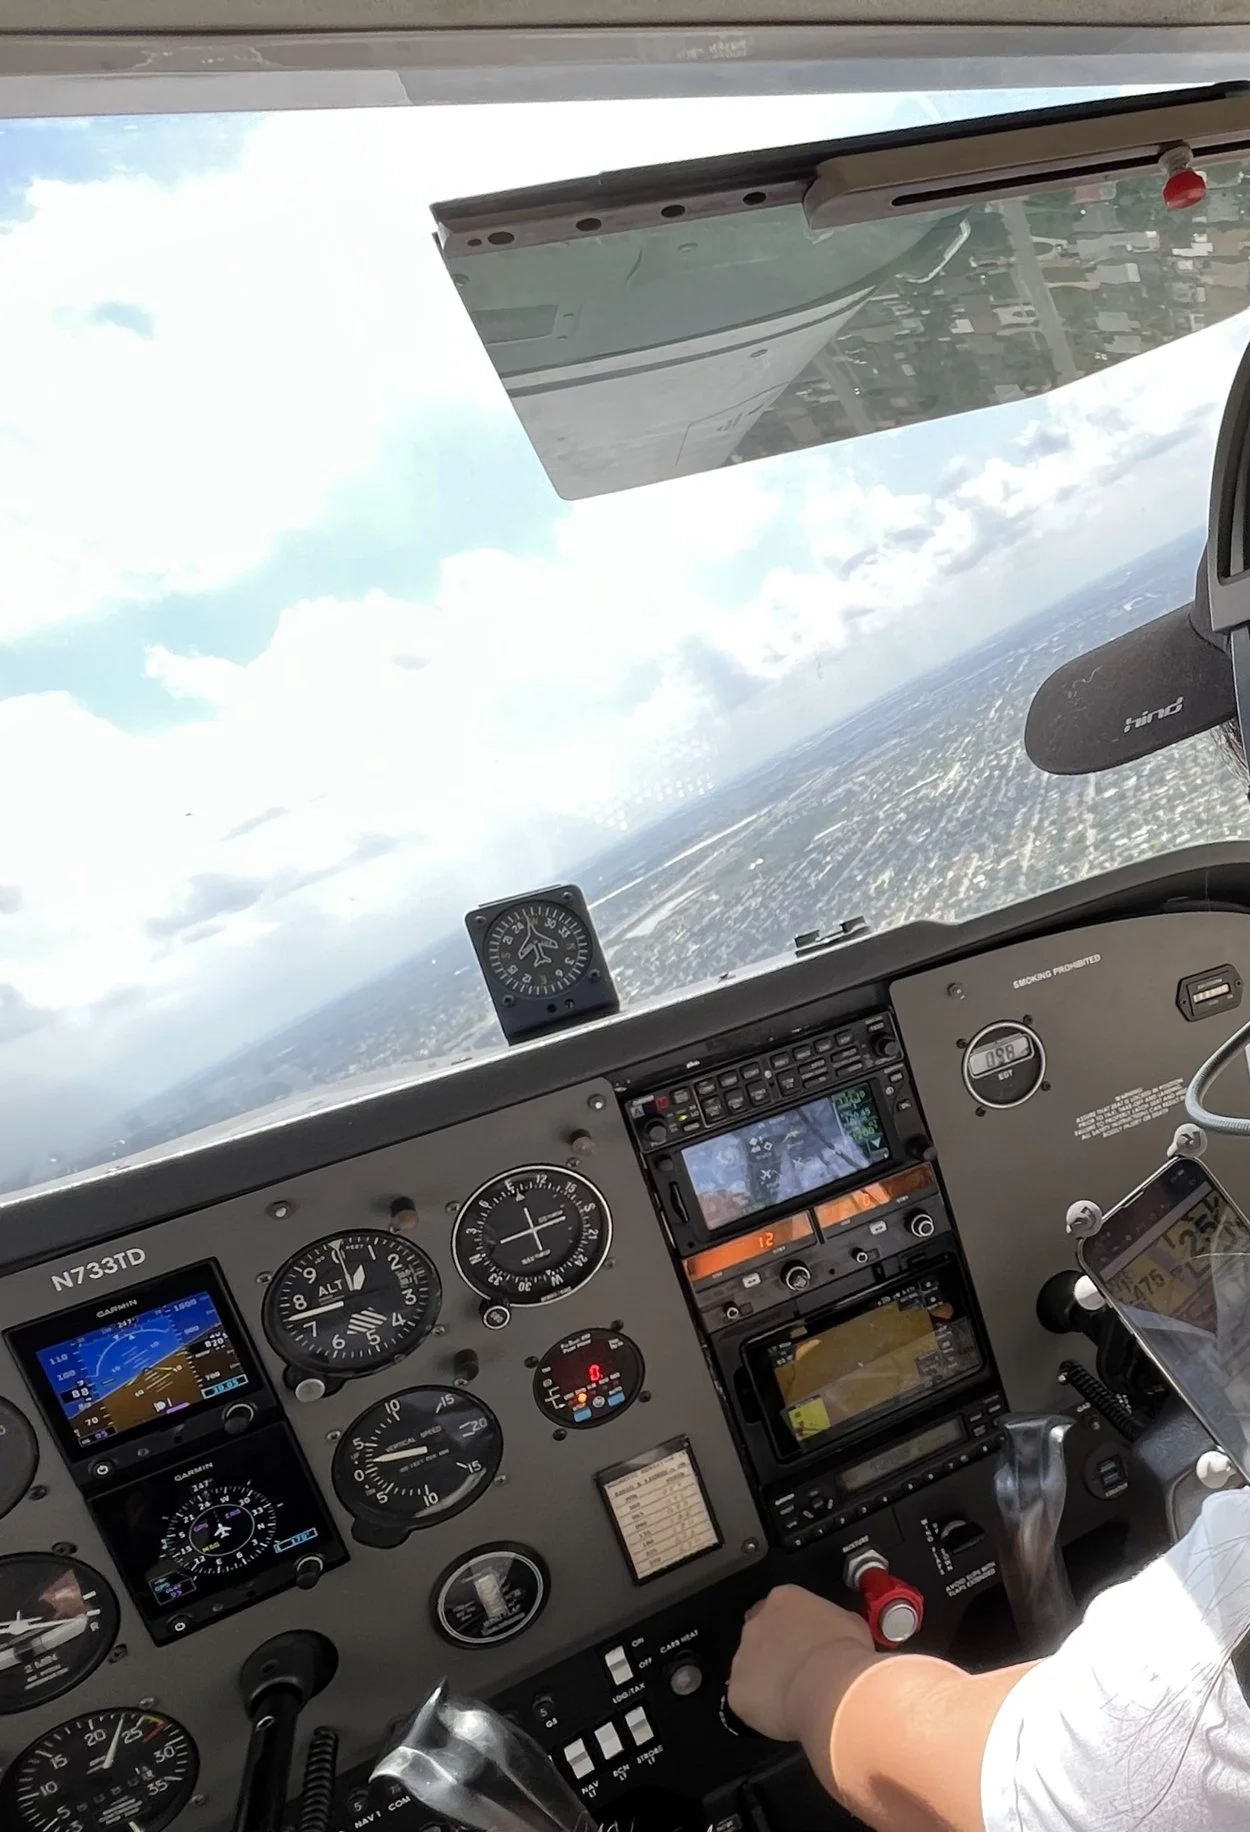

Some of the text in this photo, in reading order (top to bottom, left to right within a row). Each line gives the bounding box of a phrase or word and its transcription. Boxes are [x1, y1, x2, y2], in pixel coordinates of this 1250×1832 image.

[511, 922, 525, 934] 24
[544, 918, 557, 929] 30
[558, 927, 570, 939] 33
[1013, 953, 1101, 989] SMOKING PROHIBITED
[505, 1179, 515, 1191] E
[536, 1174, 548, 1184] 12
[565, 1181, 577, 1193] 15
[584, 1203, 596, 1212] S
[588, 1228, 599, 1240] 21
[758, 1232, 774, 1248] 12
[388, 1254, 401, 1270] 2
[469, 1254, 482, 1265] N
[574, 1254, 588, 1268] 24
[51, 1248, 146, 1292] N733TD
[303, 1266, 317, 1284] 9
[488, 1273, 502, 1286] 33
[552, 1274, 564, 1286] W
[318, 1279, 342, 1296] ALT
[518, 1281, 532, 1292] 30
[292, 1294, 308, 1310] 8
[402, 1288, 417, 1305] 3
[96, 1300, 138, 1318] GARMIN
[392, 1312, 406, 1328] 4
[303, 1320, 317, 1338] 7
[332, 1334, 346, 1350] 6
[366, 1329, 380, 1346] 5
[50, 1354, 68, 1366] 110
[57, 1370, 76, 1381] 100
[440, 1393, 455, 1406] 15
[384, 1400, 400, 1414] 10
[85, 1416, 99, 1427] 70
[471, 1418, 488, 1432] 20
[420, 1425, 442, 1438] SPEED
[352, 1438, 364, 1450] 5
[174, 1462, 214, 1482] GARMIN
[468, 1460, 482, 1473] 15
[354, 1470, 364, 1482] 0
[220, 1495, 230, 1504] W
[238, 1496, 251, 1506] 30
[376, 1491, 388, 1504] 5
[424, 1492, 438, 1506] 10
[198, 1501, 212, 1511] 24
[252, 1507, 264, 1516] 33
[183, 1514, 194, 1524] 21
[257, 1522, 266, 1530] N
[178, 1531, 186, 1539] S
[202, 1542, 220, 1552] MSG
[252, 1538, 258, 1546] 3
[90, 1621, 100, 1632] R
[631, 1637, 644, 1648] ON
[660, 1630, 699, 1654] CARB HEAT
[638, 1657, 652, 1669] OFF
[540, 1708, 548, 1717] 5
[84, 1729, 106, 1746] 20
[122, 1727, 143, 1744] 25
[153, 1746, 175, 1764] 30
[636, 1744, 664, 1764] STROBE
[648, 1756, 656, 1765] LT
[51, 1754, 68, 1770] 15
[612, 1764, 630, 1778] BCN
[620, 1772, 628, 1782] LT
[40, 1781, 58, 1796] 10
[147, 1780, 168, 1796] 35
[582, 1780, 600, 1794] NAV
[589, 1790, 597, 1798] LT
[354, 1802, 362, 1812] 5
[388, 1795, 412, 1812] COM
[57, 1805, 71, 1820] 5
[354, 1814, 375, 1829] NAV
